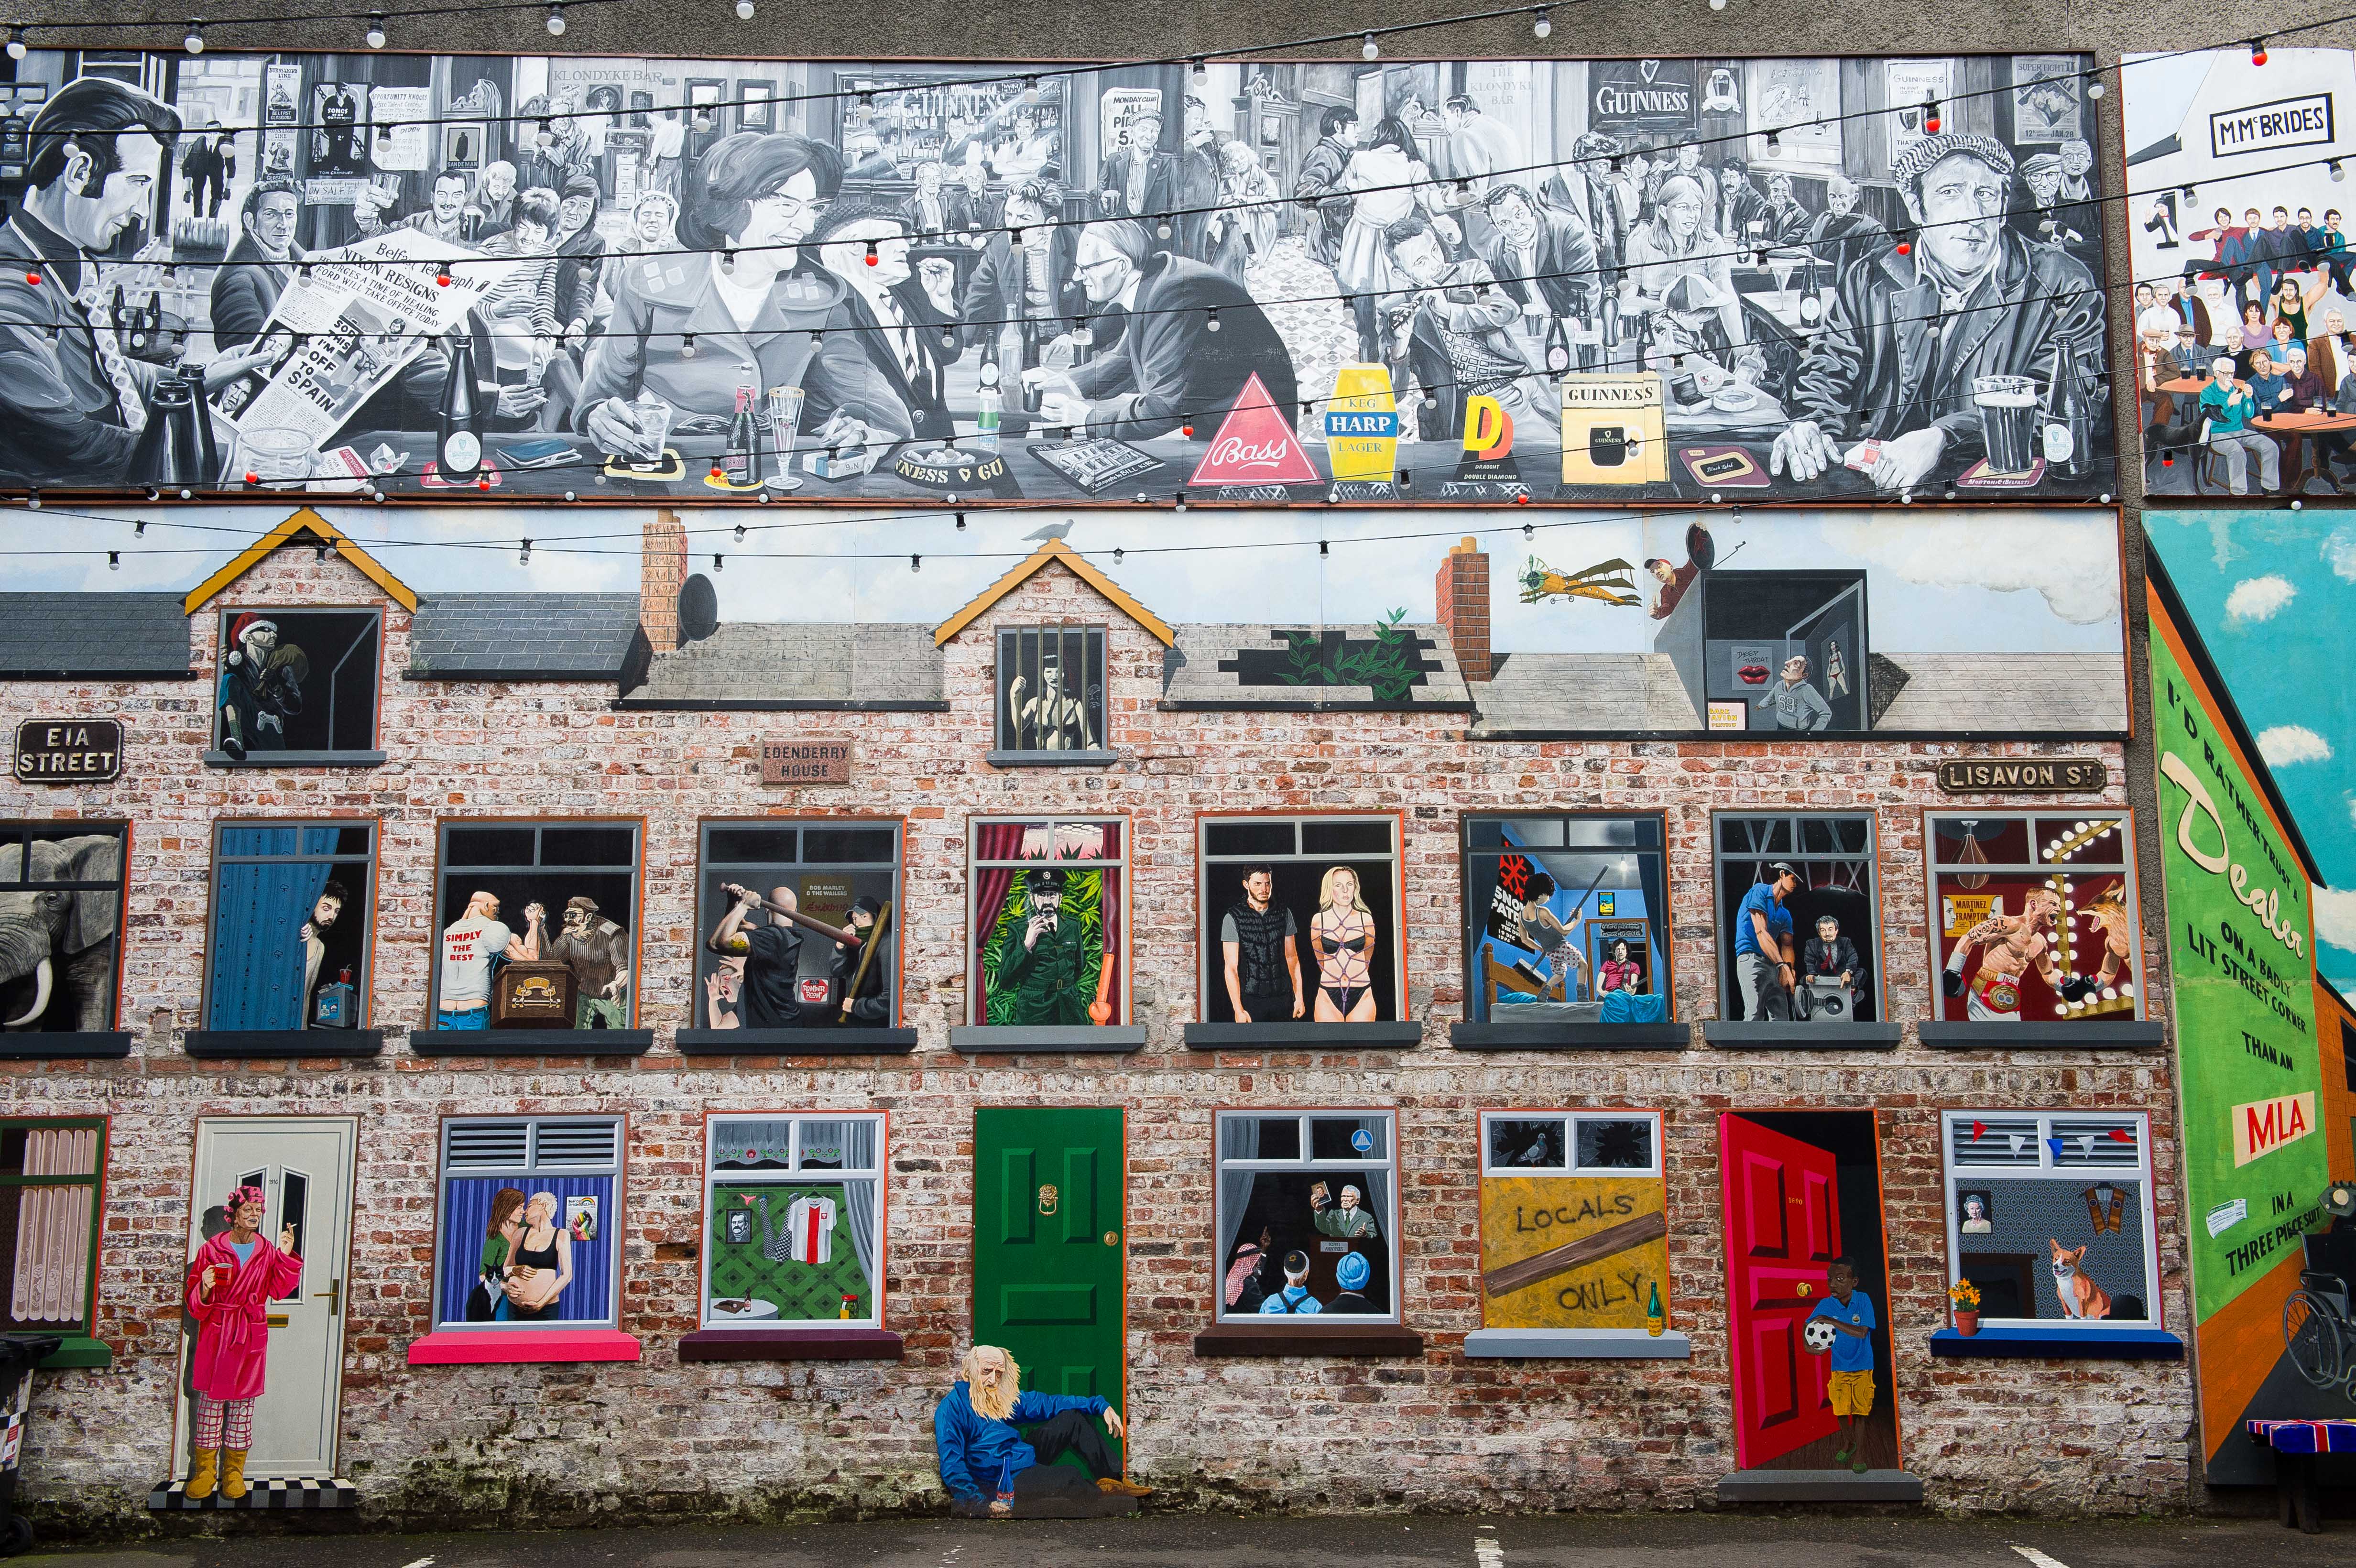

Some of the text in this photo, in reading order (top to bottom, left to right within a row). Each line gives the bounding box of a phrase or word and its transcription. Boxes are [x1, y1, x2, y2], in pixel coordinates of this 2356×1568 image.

[554, 70, 663, 82] KLONDYKE BAR
[1491, 67, 1515, 77] THE
[2018, 63, 2042, 71] SUPER
[1893, 74, 1944, 83] GUINNESS
[900, 91, 1005, 118] GUINNESS
[1491, 96, 1515, 105] BAR
[1596, 86, 1689, 114] GUINNESS
[339, 247, 440, 303] NIXON RESIGNS
[420, 261, 475, 289] Teleraph
[316, 266, 442, 328] FORD WILL TAKE OFFICE TODAY
[331, 263, 360, 280] URGES
[358, 275, 367, 283] A
[370, 278, 388, 294] TIME
[390, 290, 403, 299] OF
[404, 295, 440, 317] HEALING
[334, 320, 355, 338] SOD
[318, 339, 335, 354] I'M
[300, 361, 314, 376] TO
[309, 351, 337, 371] OFF
[288, 371, 335, 413] SPAIN
[1569, 386, 1653, 402] GUINNESS
[1349, 398, 1376, 408] KEG
[1331, 416, 1391, 432] HARP
[1211, 436, 1287, 467] Bass
[1338, 442, 1382, 453] LAGER
[1121, 466, 1139, 477] BILL
[1140, 459, 1157, 469] KIRK
[1736, 650, 1759, 659] DEEP
[1778, 693, 1795, 714] 69
[46, 728, 90, 747] EIA
[19, 752, 114, 772] STREET
[764, 747, 848, 759] EDENDERRY
[782, 764, 829, 777] HOUSE
[1949, 765, 2054, 786] LISAVON
[2168, 677, 2298, 903] I'D RATHER TRUST A
[1491, 898, 1519, 923] PATR
[1956, 900, 1987, 909] MARTINEZ
[1505, 920, 1516, 930] LIVE
[1956, 912, 1988, 921] FRAMPTON
[446, 929, 482, 942] SIMPLY
[1506, 932, 1515, 940] DEC
[452, 944, 472, 952] THE
[2221, 921, 2291, 999] ON A BADLY
[2187, 922, 2307, 1034] LIT STREET CORNER
[2241, 1031, 2294, 1071] THAN AN
[2247, 1099, 2306, 1155] MLA
[2271, 1191, 2294, 1216] IN A
[1516, 1195, 1635, 1232] LOCALS
[2225, 1230, 2275, 1277] THREE
[2304, 1206, 2321, 1227] SUIT
[1558, 1273, 1642, 1310] ONLY
